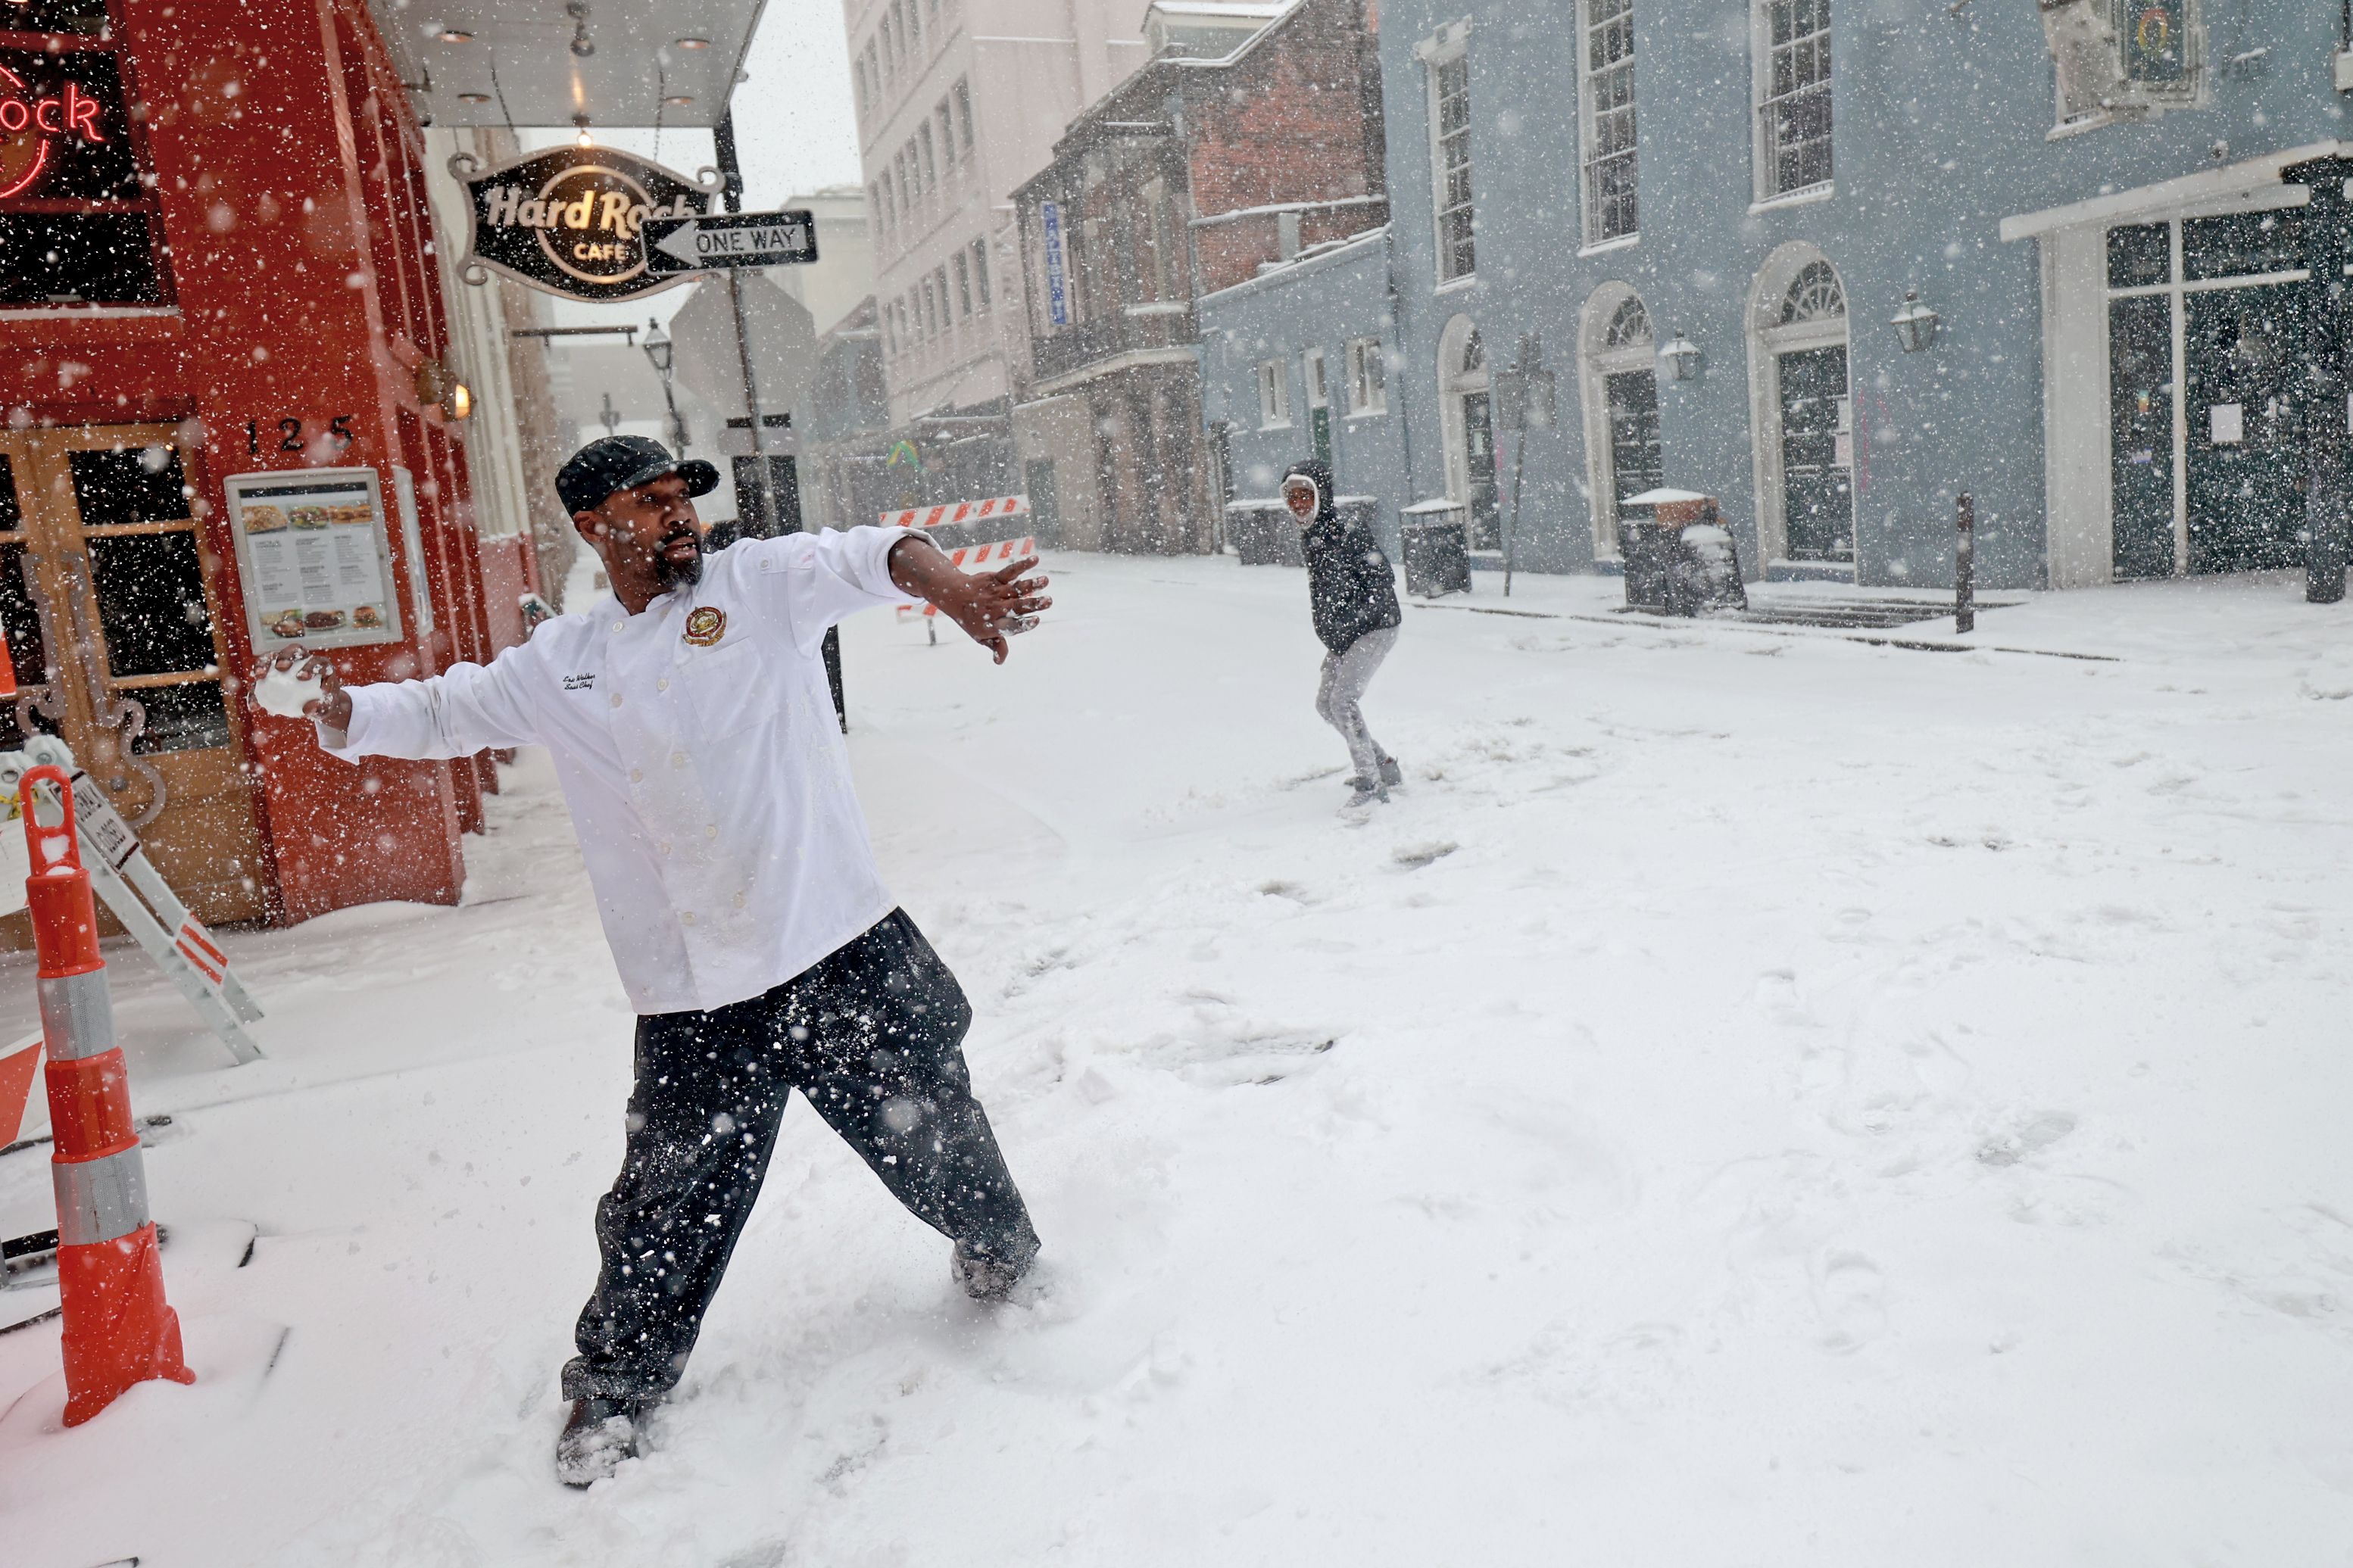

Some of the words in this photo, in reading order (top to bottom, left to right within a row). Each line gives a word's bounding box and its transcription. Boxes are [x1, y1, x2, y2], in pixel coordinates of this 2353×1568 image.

[487, 186, 595, 229] Hard
[573, 243, 627, 261] CAFE
[696, 232, 744, 253] ONE
[750, 228, 796, 250] WAY
